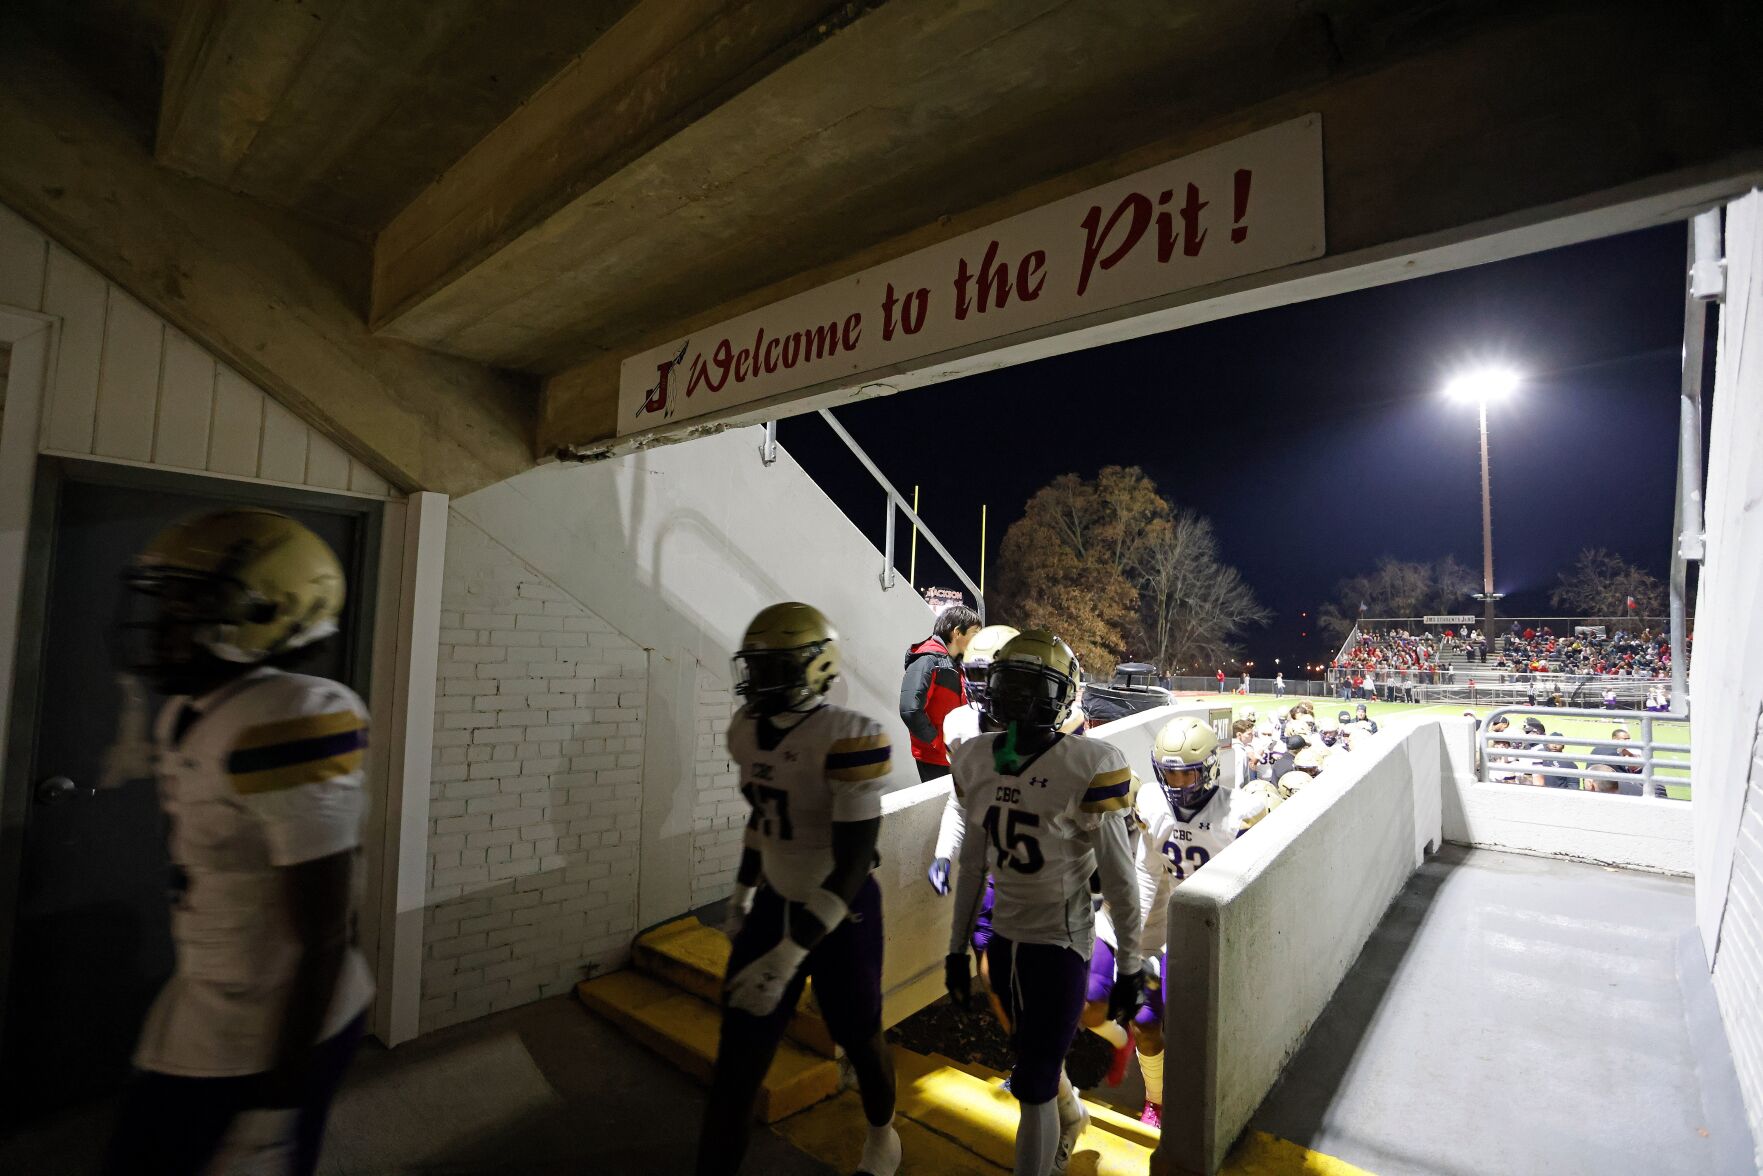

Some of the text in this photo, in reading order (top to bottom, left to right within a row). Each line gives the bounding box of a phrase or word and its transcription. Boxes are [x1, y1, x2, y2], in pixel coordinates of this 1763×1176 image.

[686, 313, 862, 399] Welcome
[882, 282, 932, 342] to
[953, 240, 1047, 321] the
[1076, 182, 1211, 297] Pit
[1212, 718, 1229, 740] EXIT
[1260, 752, 1277, 765] 35
[995, 785, 1021, 804] CBC
[982, 805, 1045, 875] 15
[1173, 829, 1193, 842] CBC
